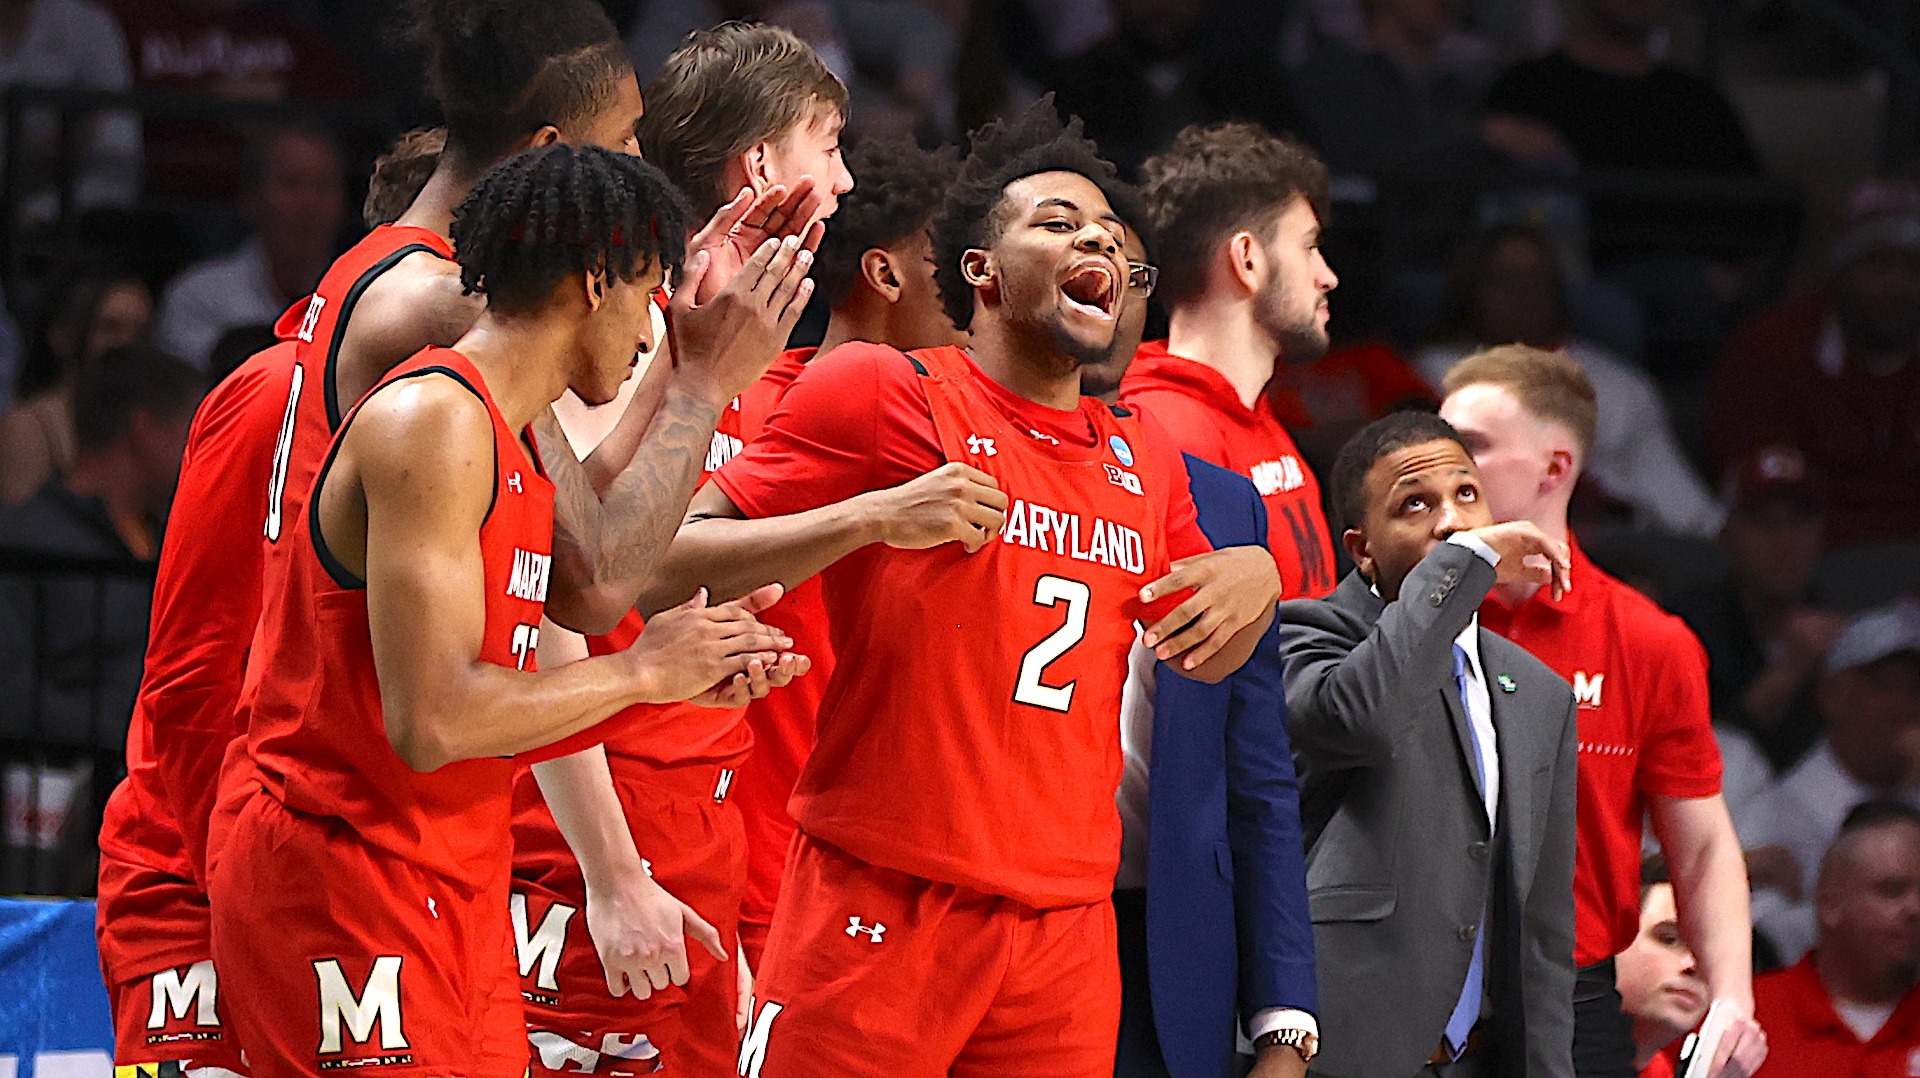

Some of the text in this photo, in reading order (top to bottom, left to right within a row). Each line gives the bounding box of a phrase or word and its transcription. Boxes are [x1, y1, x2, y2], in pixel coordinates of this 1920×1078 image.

[999, 499, 1145, 575] ARYLAND
[1012, 573, 1092, 714] 2
[1572, 671, 1605, 707] M
[147, 958, 221, 1030] M
[312, 955, 411, 1055] M
